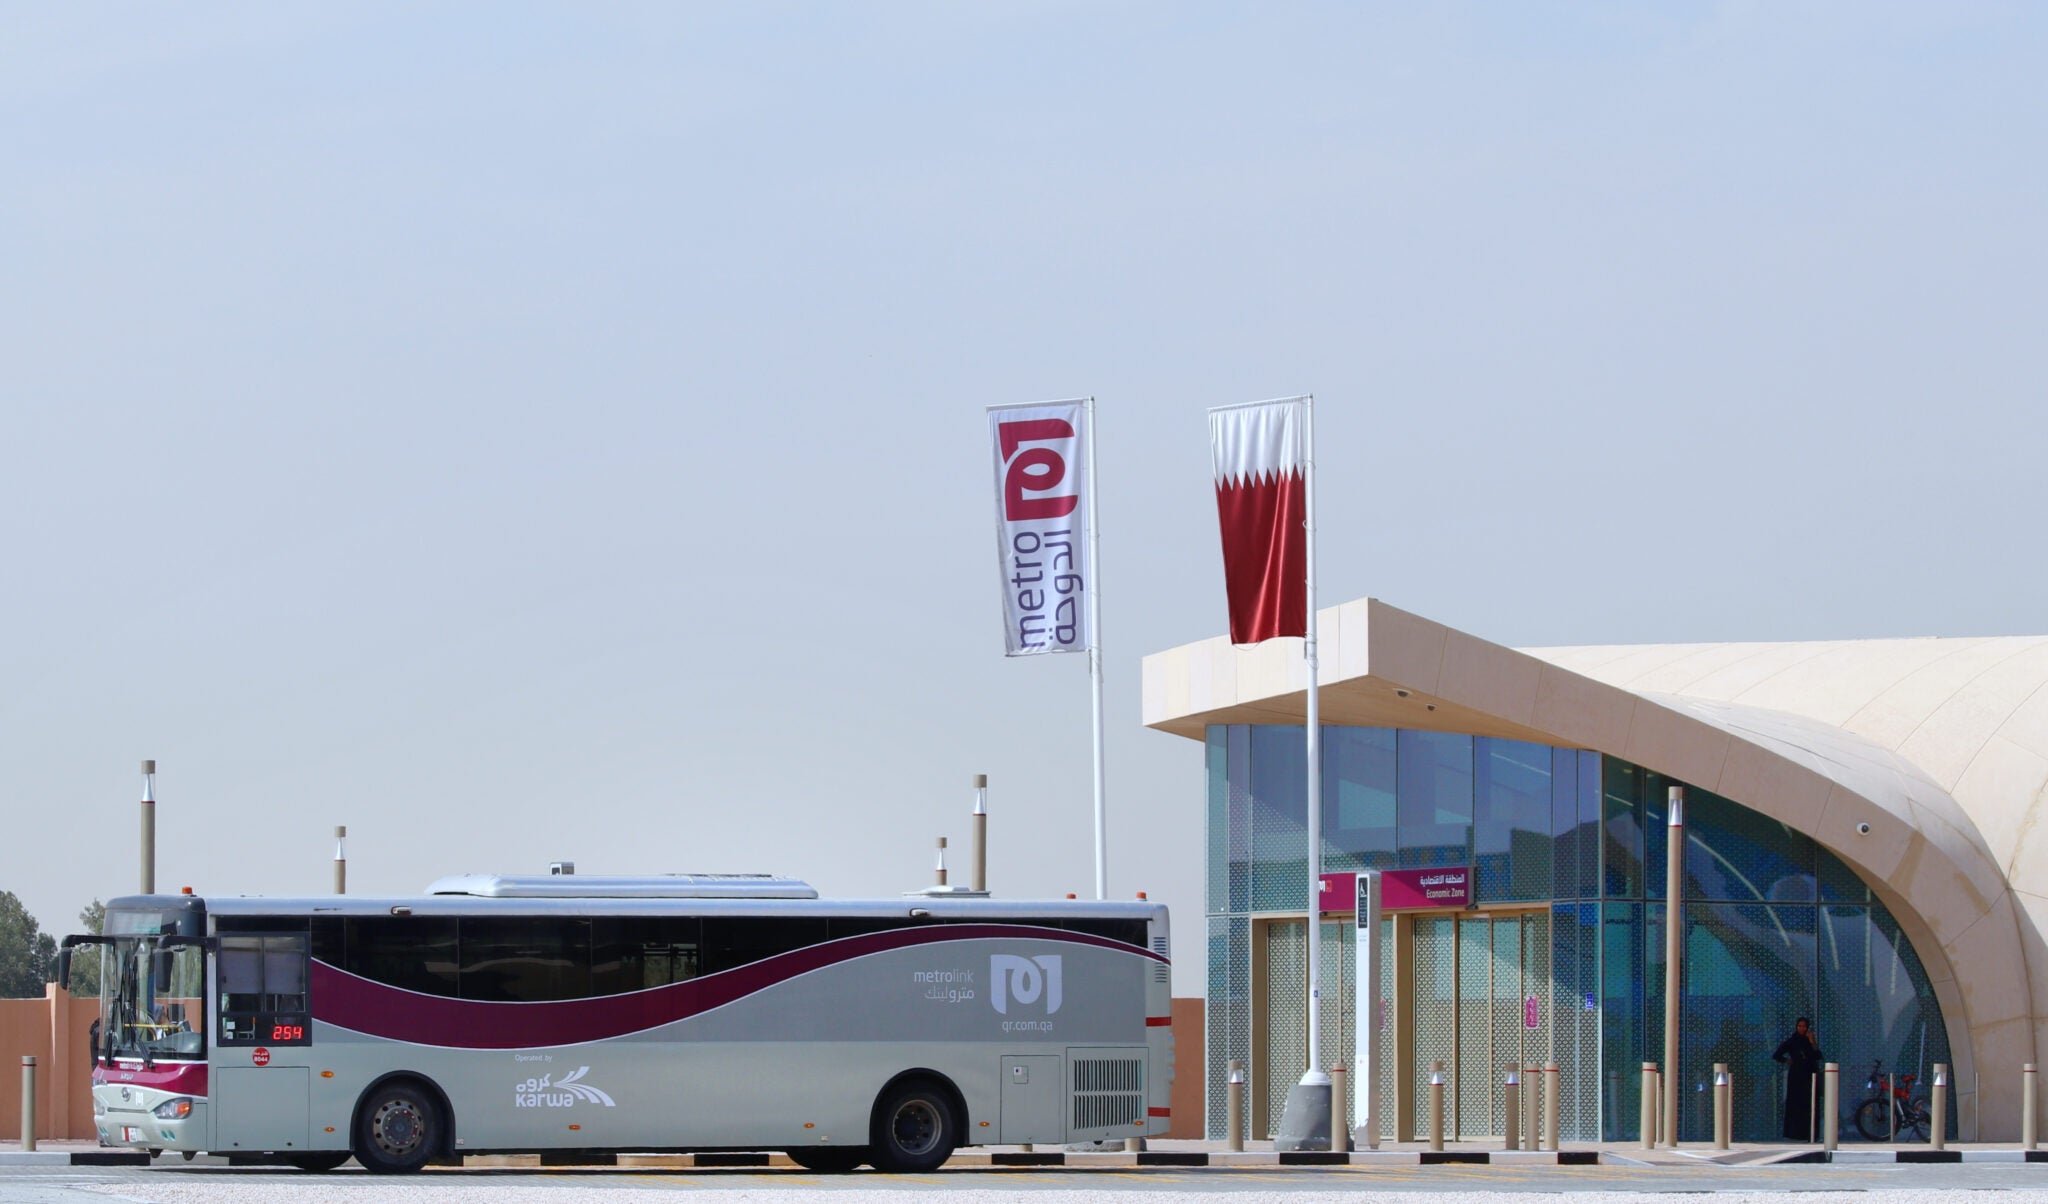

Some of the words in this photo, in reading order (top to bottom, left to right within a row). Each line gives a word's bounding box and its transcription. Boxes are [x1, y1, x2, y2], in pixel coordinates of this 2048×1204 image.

[1011, 530, 1047, 649] metro
[1043, 528, 1084, 646] الدوحة
[1426, 888, 1450, 899] Economic
[1451, 887, 1465, 898] Zone
[913, 968, 975, 983] metrolink
[924, 984, 975, 1003] مترولينك
[272, 1025, 303, 1040] 254
[1001, 1020, 1053, 1033] qr.com.qa
[514, 1054, 543, 1063] Operated
[544, 1054, 553, 1063] by
